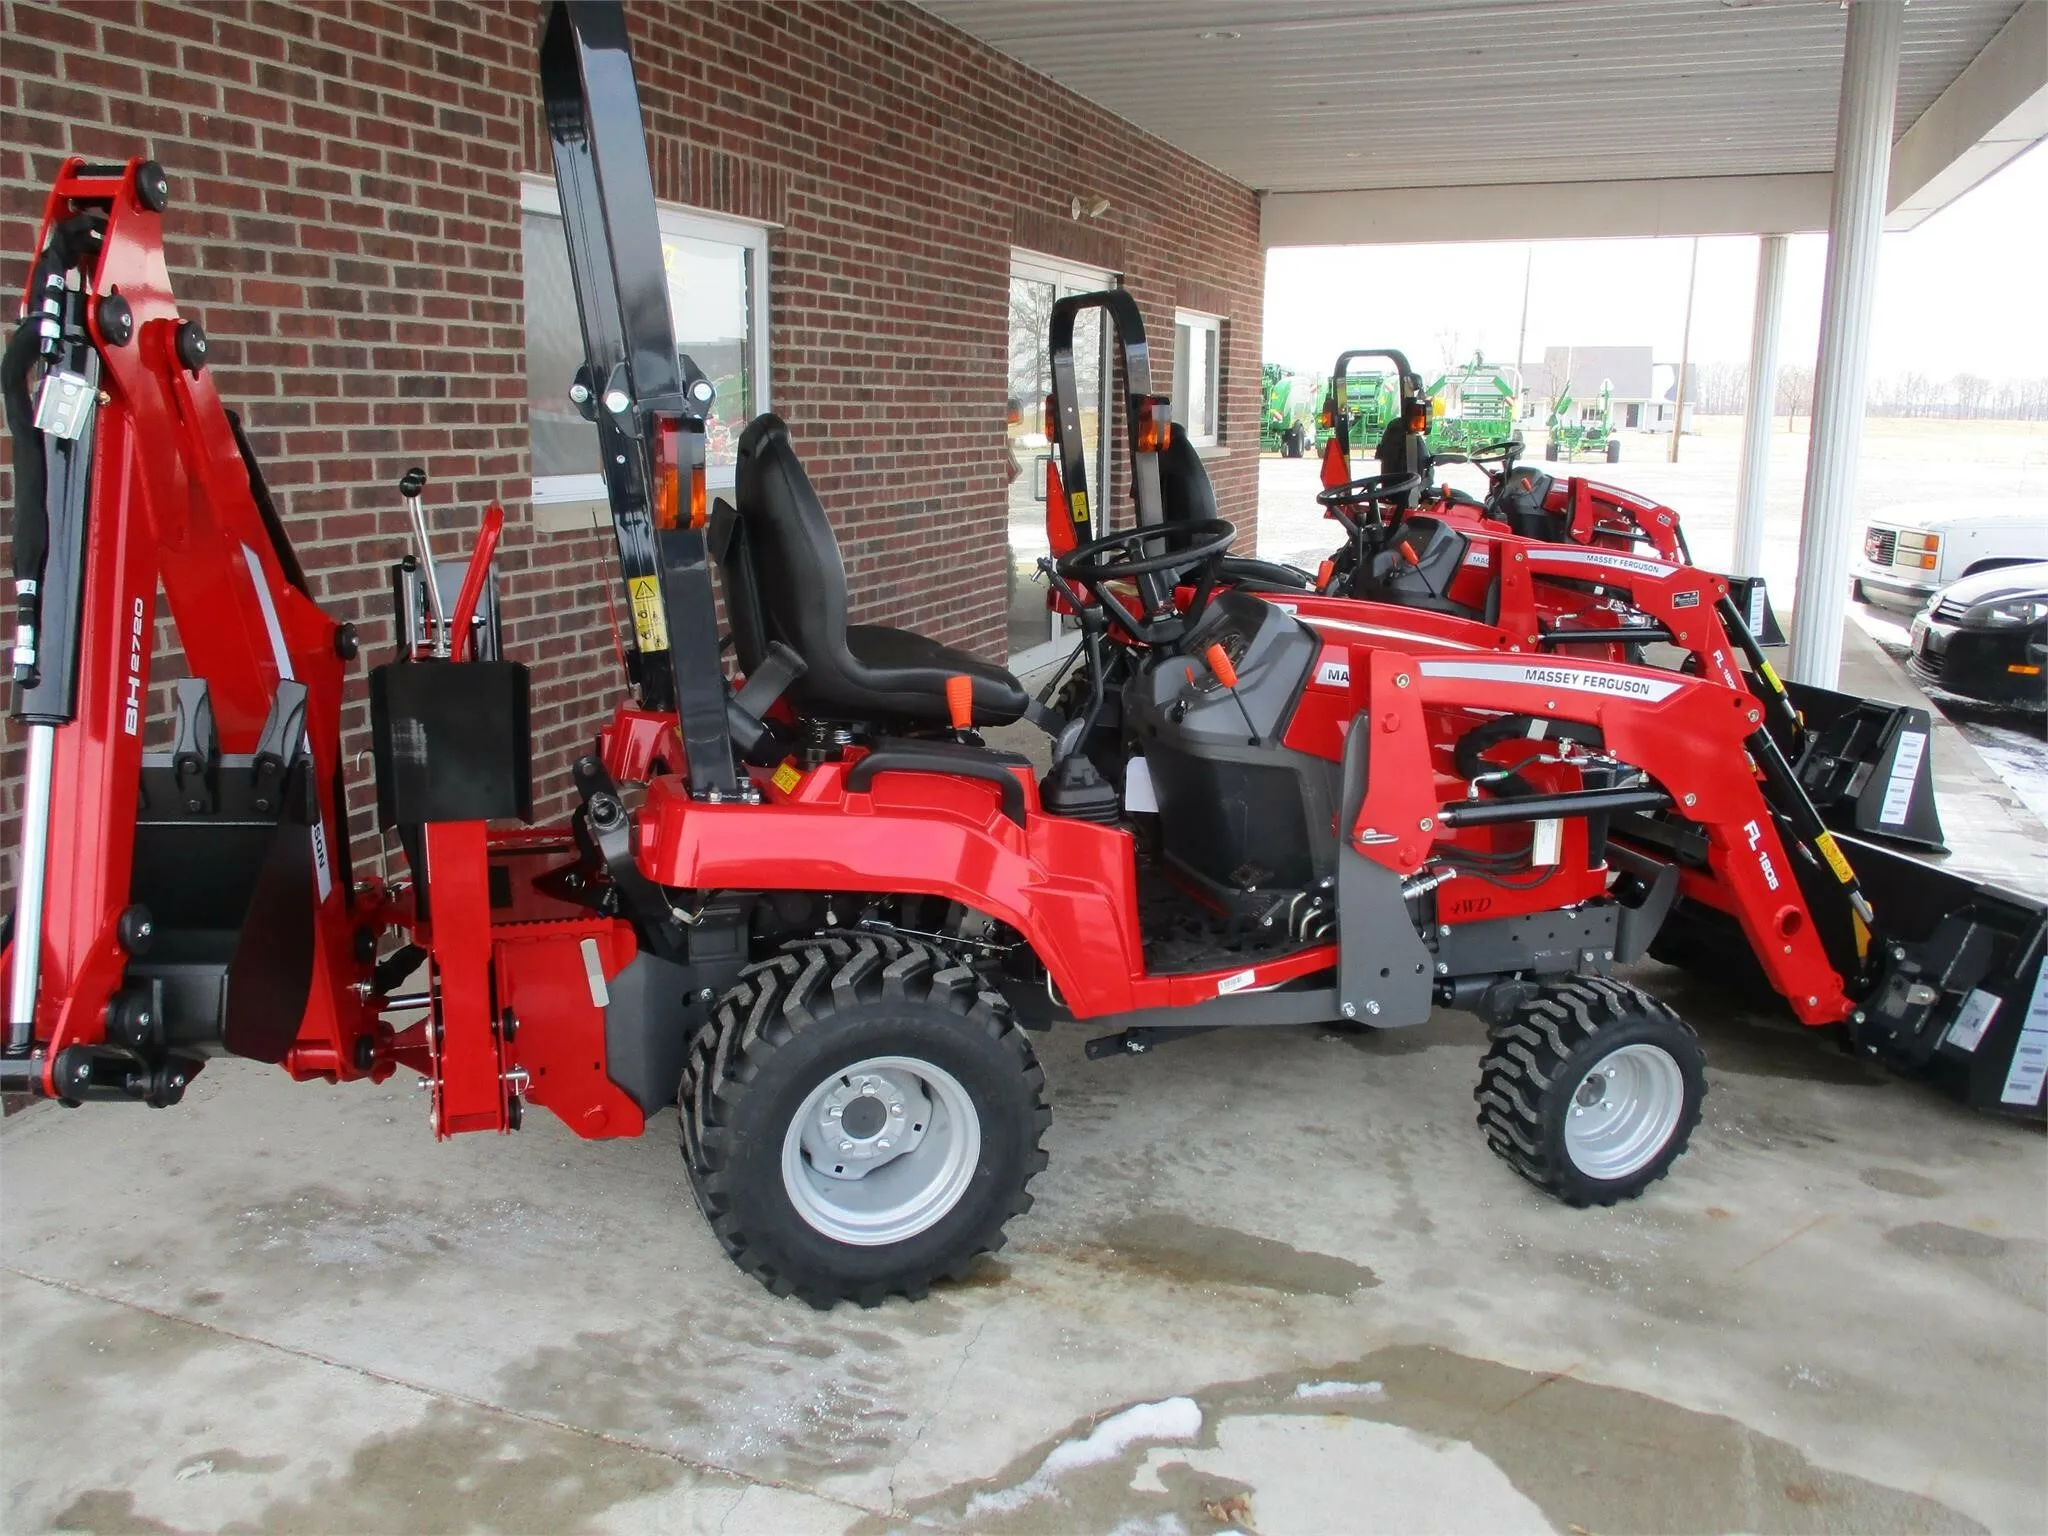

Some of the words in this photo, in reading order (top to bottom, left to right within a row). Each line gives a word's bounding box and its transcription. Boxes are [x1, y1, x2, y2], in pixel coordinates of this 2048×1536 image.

[1586, 554, 1619, 565] MASSEY
[1619, 559, 1659, 573] FERGUSON
[130, 597, 143, 673] 2720
[1713, 649, 1724, 669] FL
[1525, 669, 1579, 684] MASSEY
[1583, 675, 1650, 694] FERGUSON
[124, 675, 141, 736] BH
[1743, 820, 1761, 852] FL
[1759, 851, 1779, 891] 1805
[1450, 897, 1492, 915] 4WD
